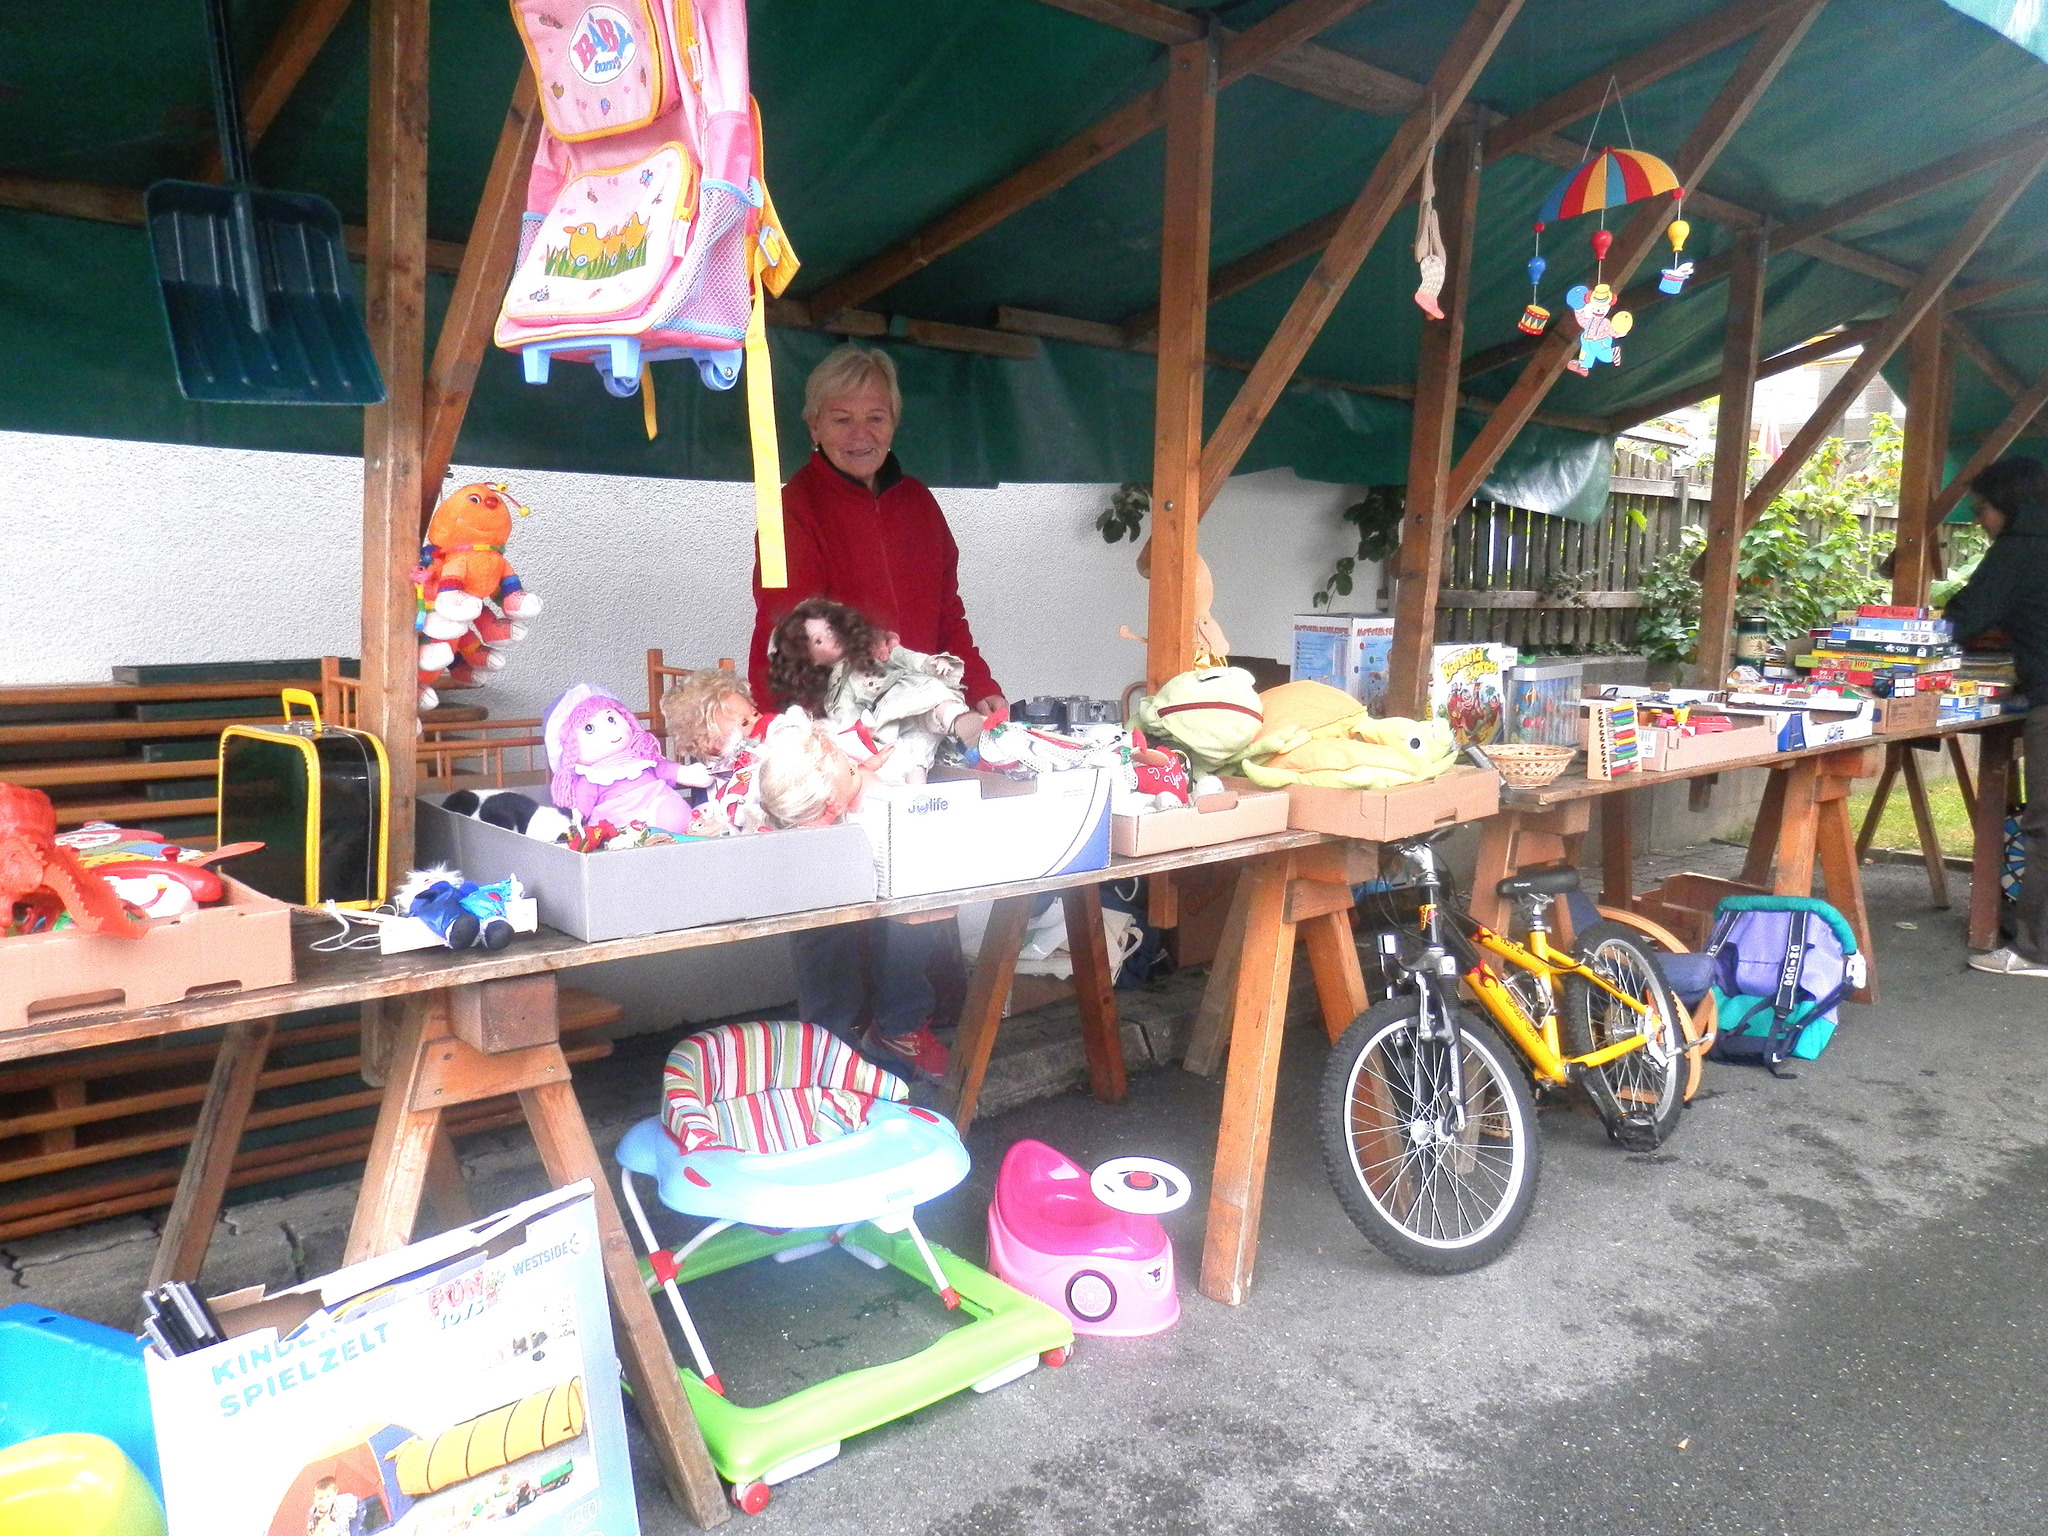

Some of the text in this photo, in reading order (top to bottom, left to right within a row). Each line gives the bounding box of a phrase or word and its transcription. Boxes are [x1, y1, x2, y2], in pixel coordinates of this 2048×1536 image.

[573, 17, 634, 72] BABY
[1440, 646, 1485, 685] Banana
[1853, 660, 1869, 668] 100
[1894, 645, 1909, 653] 500
[512, 1241, 569, 1277] WESTSIDE
[428, 1269, 484, 1317] FUN
[211, 1326, 338, 1386] KIND
[220, 1321, 388, 1418] SPIELZELT
